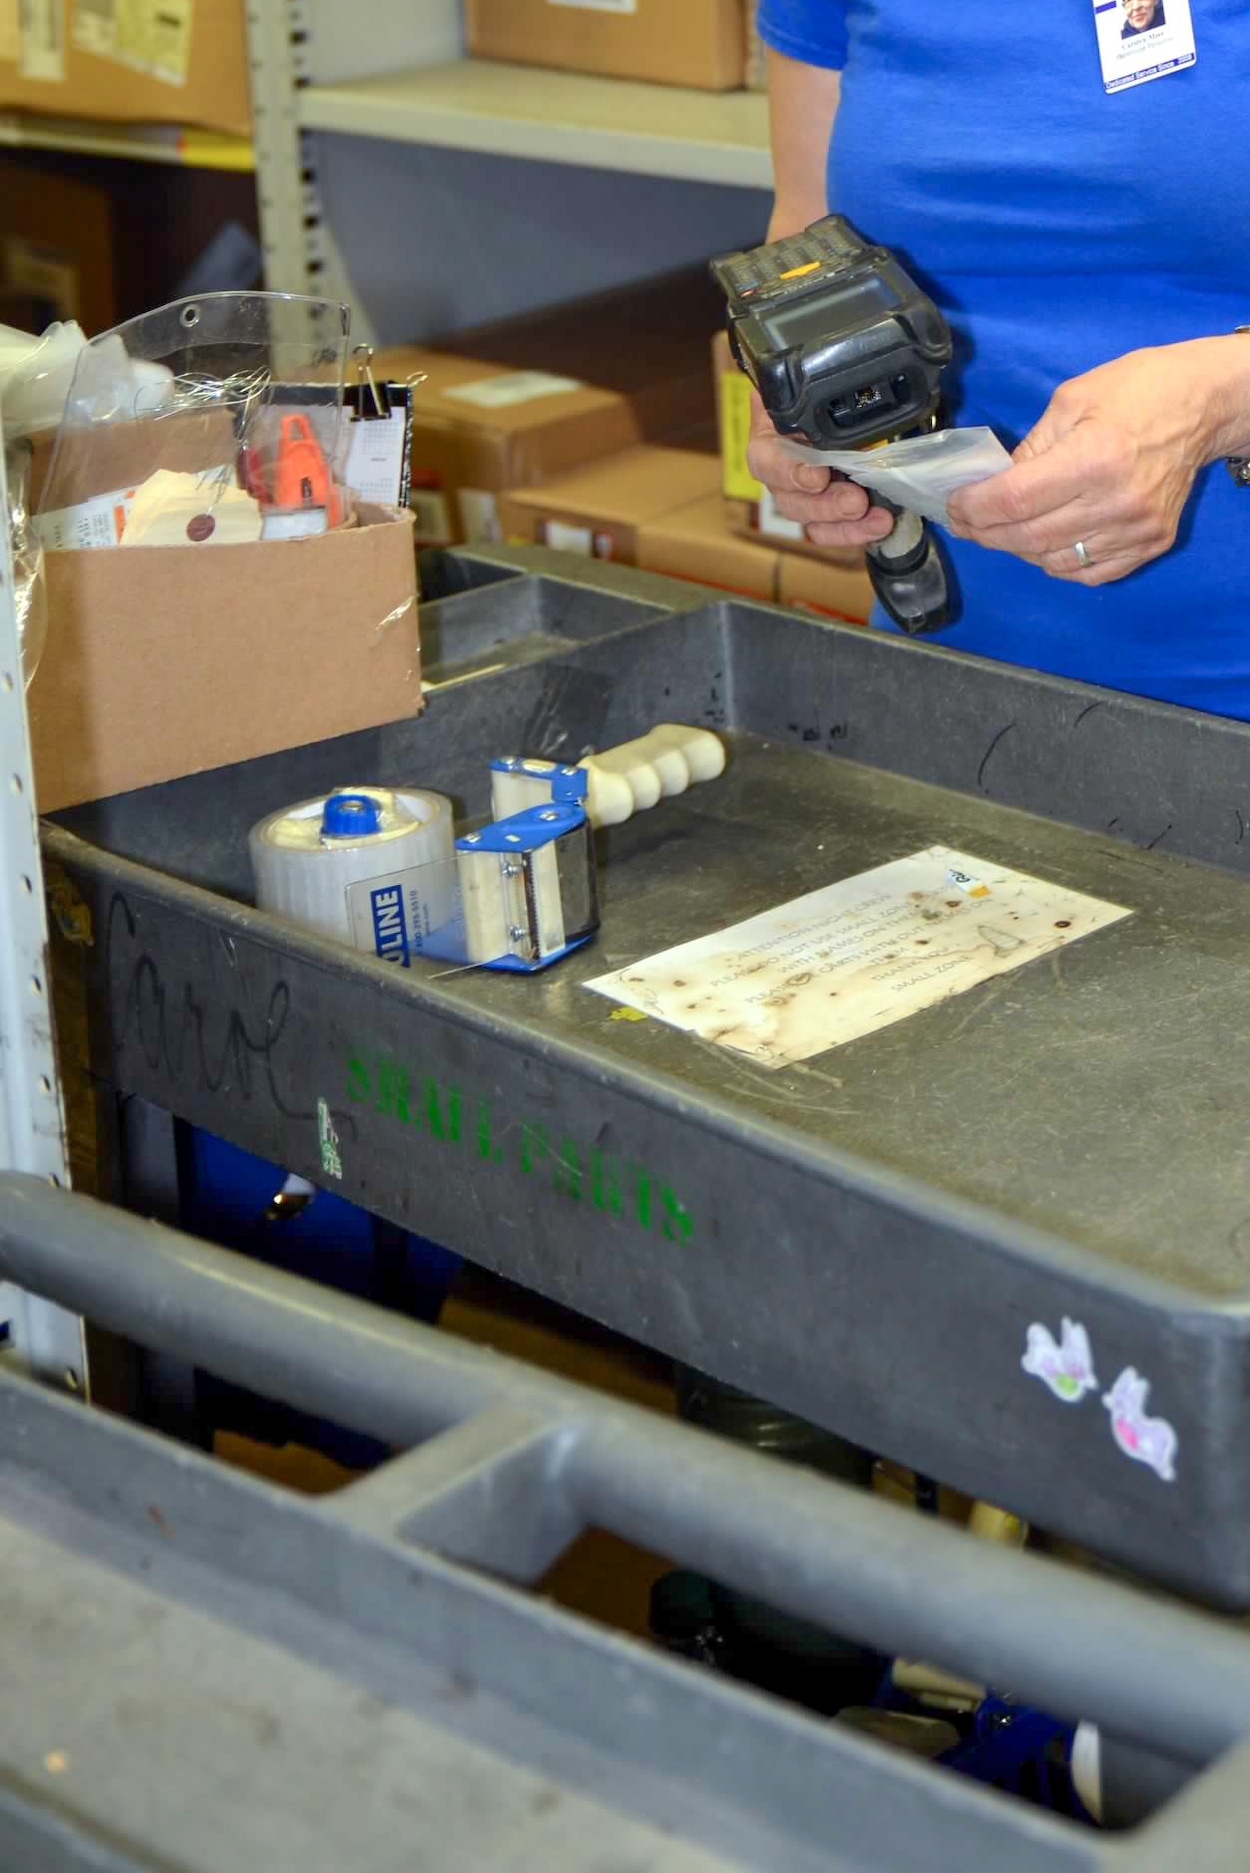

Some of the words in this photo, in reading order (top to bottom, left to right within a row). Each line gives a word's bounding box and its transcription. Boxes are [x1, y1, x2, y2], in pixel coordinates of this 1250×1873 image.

[737, 927, 807, 959] ATTENTION
[781, 943, 808, 958] NOT
[841, 917, 876, 936] SMALL
[781, 954, 813, 973] WITH
[892, 971, 937, 992] SMALL
[935, 954, 973, 974] ZONE
